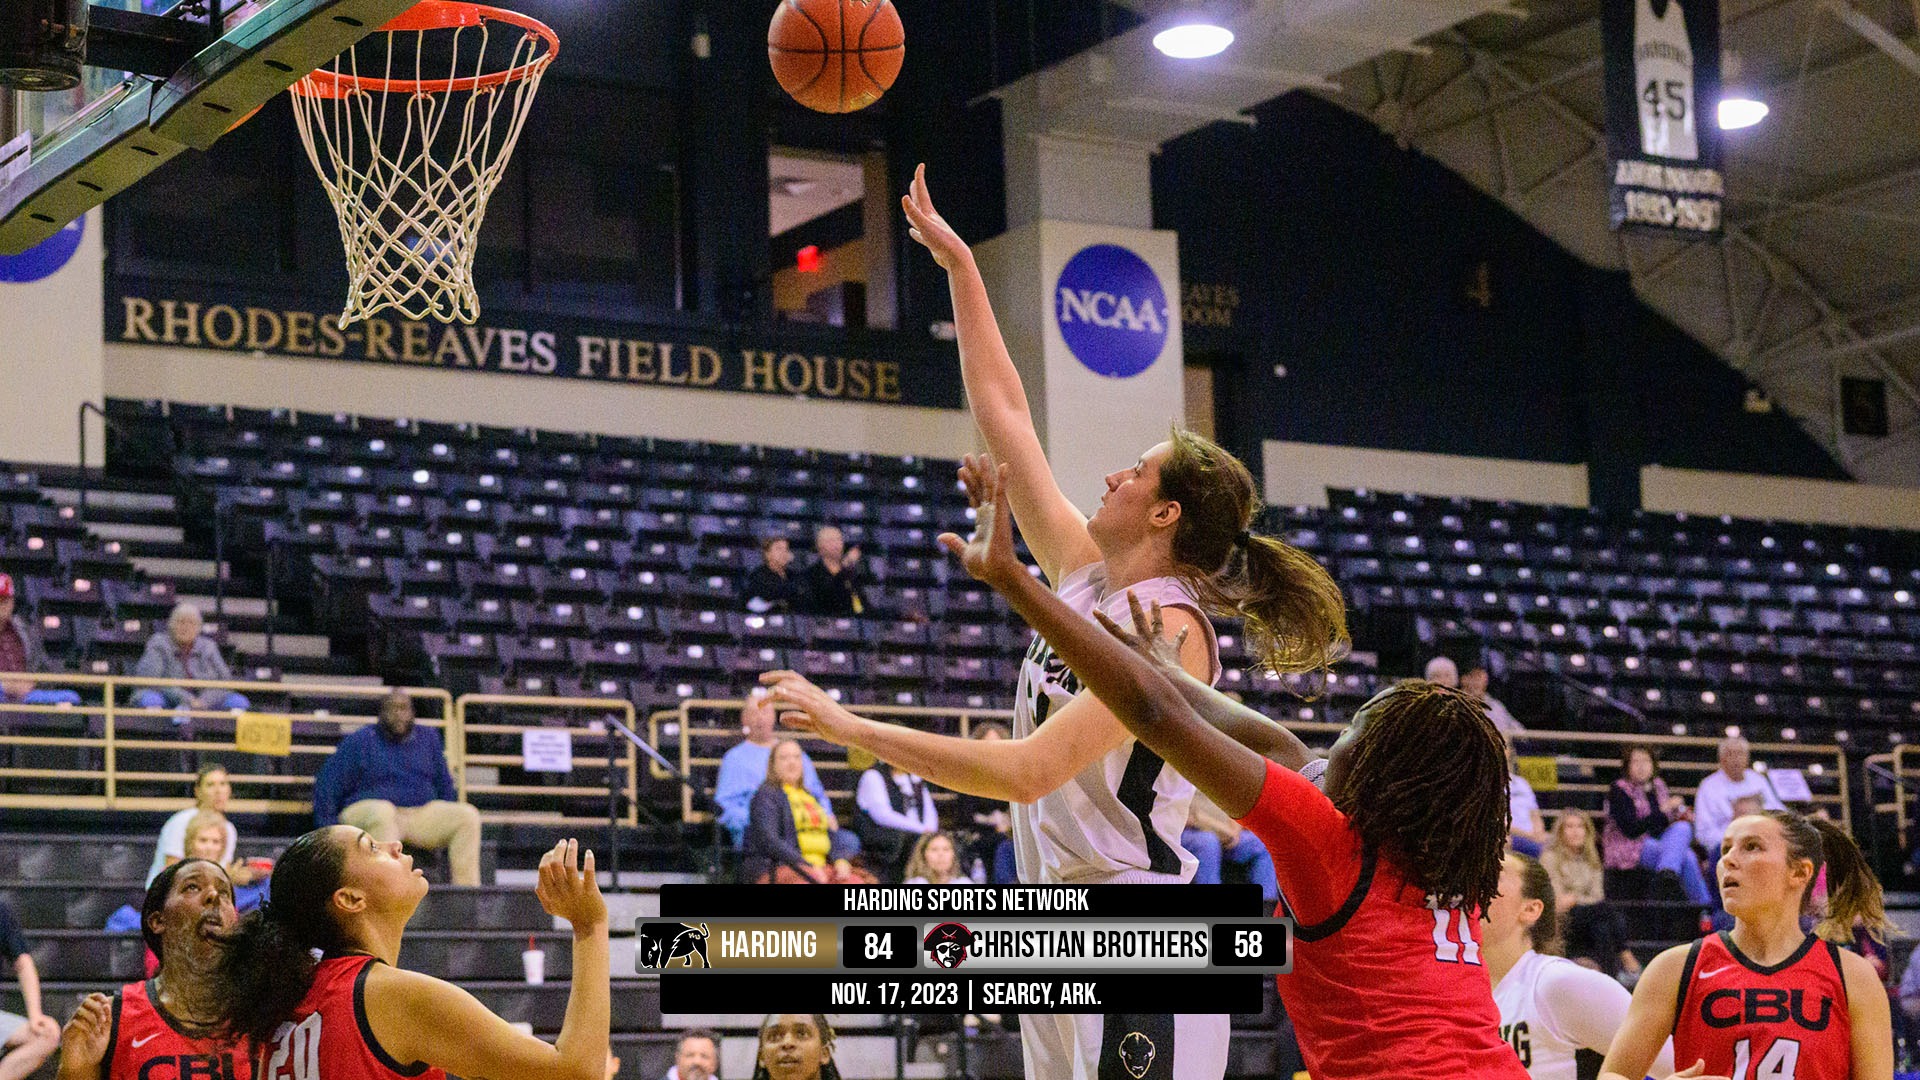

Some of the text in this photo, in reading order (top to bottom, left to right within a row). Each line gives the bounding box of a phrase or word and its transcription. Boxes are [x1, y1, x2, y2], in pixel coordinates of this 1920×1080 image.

[1644, 78, 1686, 120] 45
[1060, 287, 1162, 334] NCAA
[122, 297, 901, 399] RHODES-REAVES FIELD HOUSE
[1425, 893, 1482, 966] 11
[1701, 988, 1833, 1031] CBU
[267, 1010, 323, 1080] 20
[1732, 1037, 1801, 1080] 14
